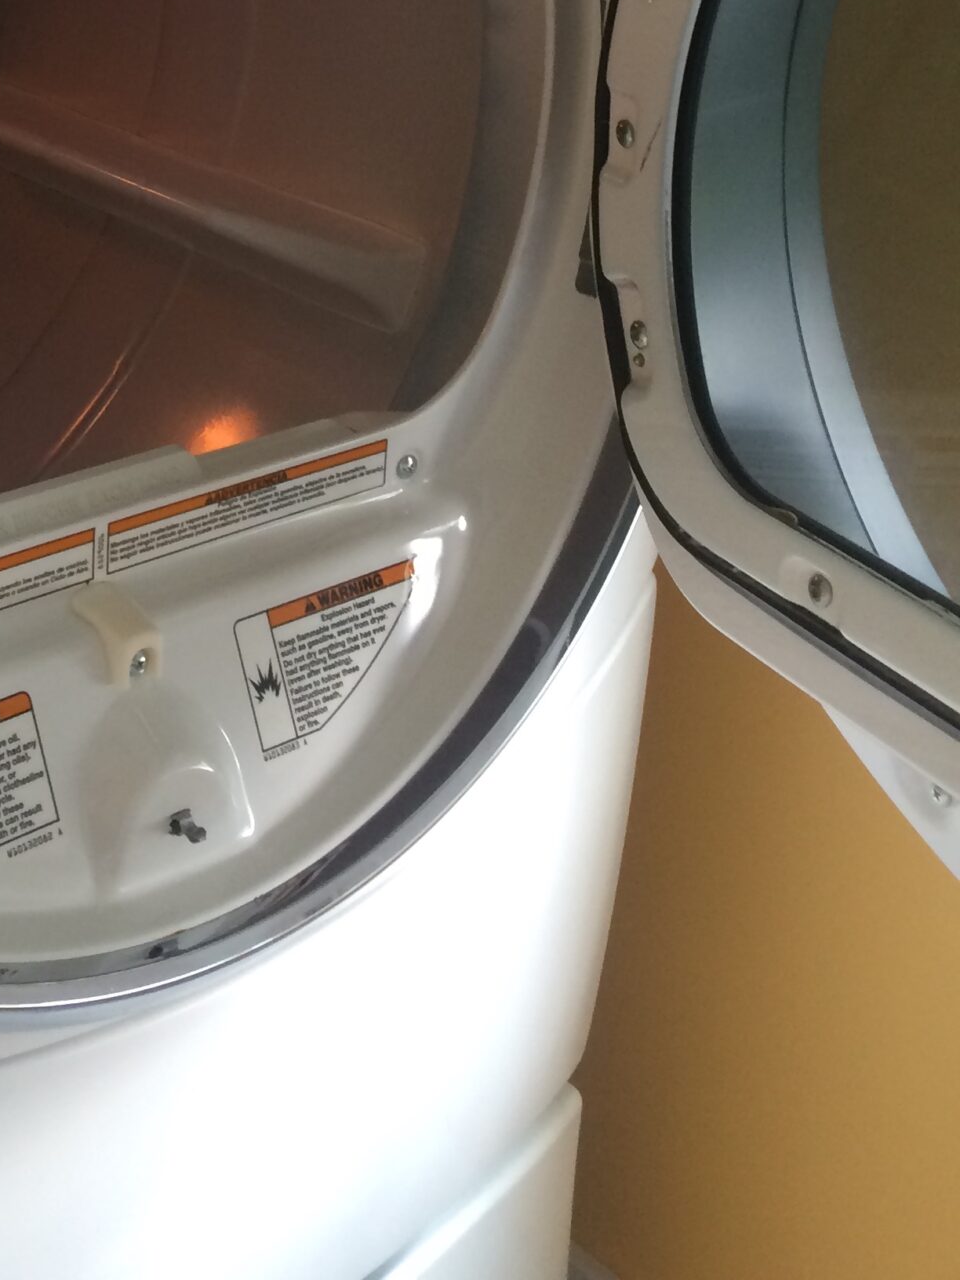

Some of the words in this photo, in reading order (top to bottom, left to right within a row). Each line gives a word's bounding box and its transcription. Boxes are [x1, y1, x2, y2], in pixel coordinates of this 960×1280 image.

[216, 470, 287, 501] ADVERTENCIA
[317, 573, 384, 607] WARNING
[320, 606, 352, 622] Explosion
[352, 597, 375, 609] Hazard
[278, 638, 296, 648] Keep
[296, 625, 329, 642] flammable
[330, 614, 359, 629] materials
[360, 608, 372, 619] and
[280, 645, 297, 657] such
[298, 643, 306, 651] as
[306, 633, 336, 649] gasoline,
[336, 626, 353, 637] away
[353, 620, 369, 630] from
[282, 659, 293, 668] Do
[293, 654, 305, 664] not
[306, 651, 317, 660] dry
[317, 640, 346, 655] anything
[346, 634, 359, 644] that
[359, 630, 372, 639] has
[372, 624, 385, 634] ever
[285, 666, 298, 677] had
[299, 656, 327, 672] anything
[327, 644, 360, 660] flammable
[361, 640, 370, 648] on
[289, 683, 312, 696] Failure
[312, 679, 320, 687] to
[321, 672, 340, 683] follow
[341, 665, 359, 676] these
[306, 668, 321, 678] after
[331, 681, 343, 690] can
[294, 701, 313, 713] result
[296, 706, 328, 723] explosion
[298, 724, 306, 732] or
[7, 733, 20, 744] oil.
[6, 744, 22, 757] had
[22, 740, 36, 754] any
[2, 770, 44, 792] clothesline
[7, 771, 16, 780] or
[2, 802, 24, 816] these
[4, 814, 19, 826] can
[20, 803, 42, 819] result
[9, 825, 18, 835] or
[18, 819, 34, 830] fire.
